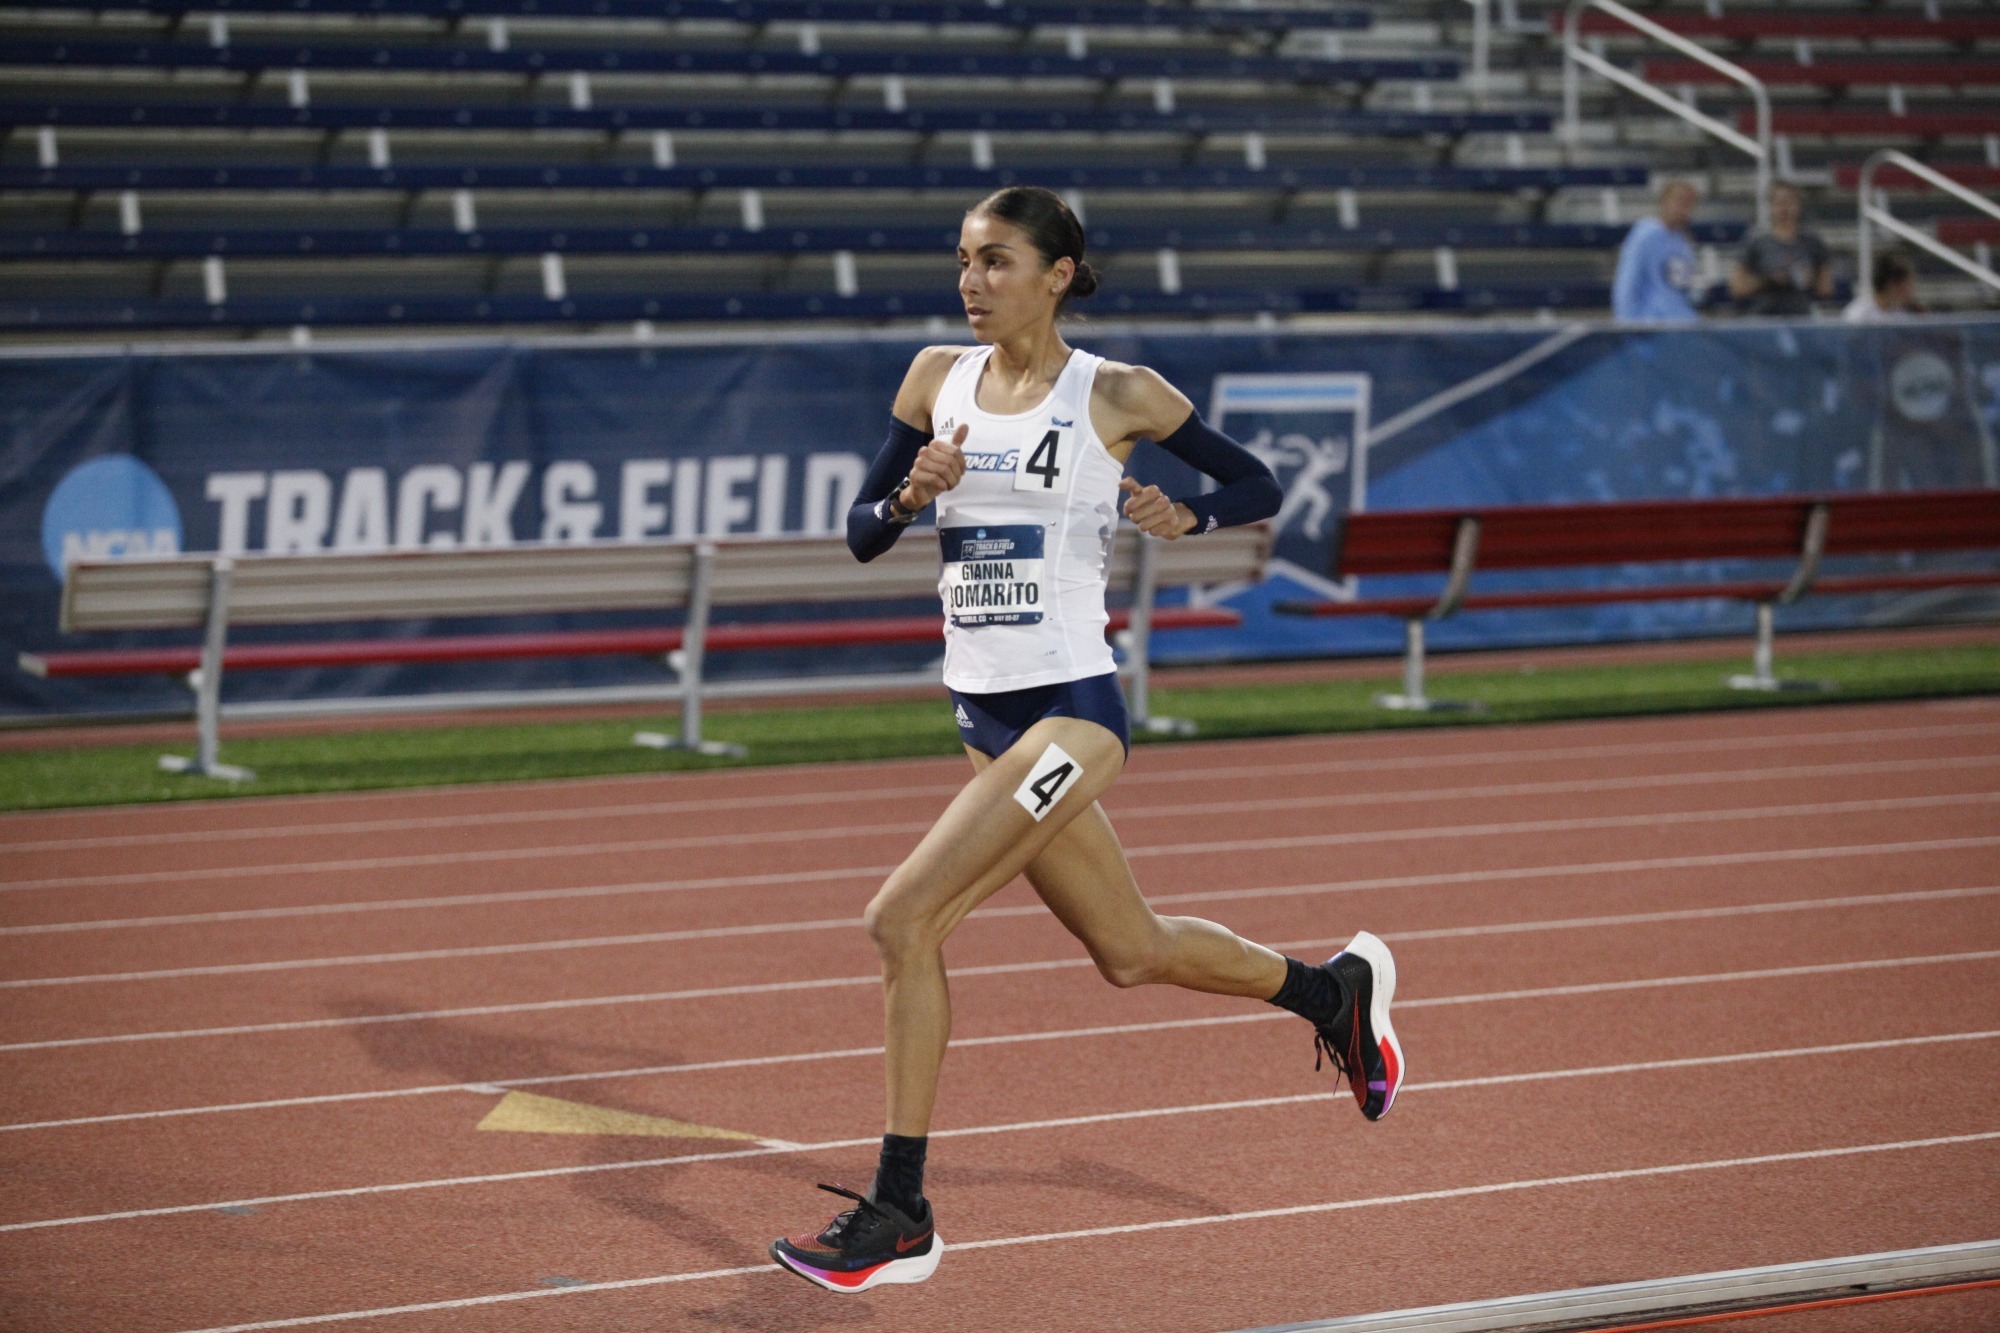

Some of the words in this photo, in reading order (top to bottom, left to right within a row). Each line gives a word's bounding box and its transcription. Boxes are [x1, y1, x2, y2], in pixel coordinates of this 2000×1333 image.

[1025, 429, 1060, 489] 4
[205, 460, 531, 552] TRACK
[541, 460, 600, 543] &
[618, 453, 868, 541] FIELD
[962, 562, 1014, 581] GIANNA
[1030, 761, 1075, 814] 4
